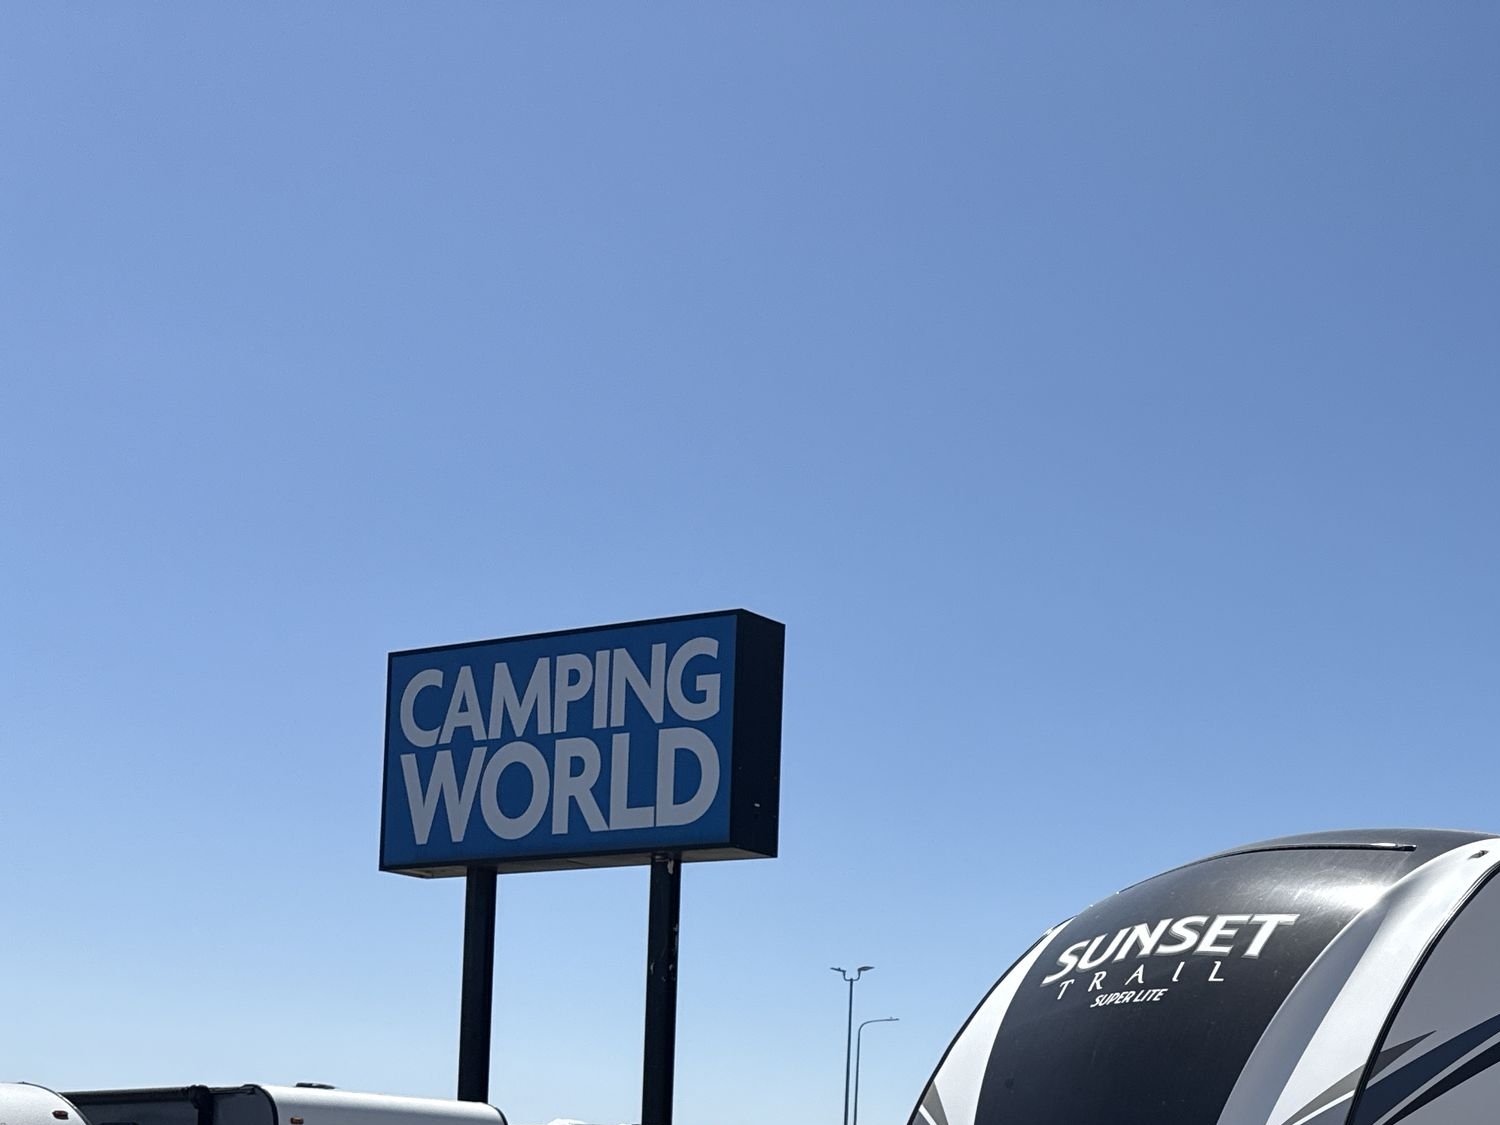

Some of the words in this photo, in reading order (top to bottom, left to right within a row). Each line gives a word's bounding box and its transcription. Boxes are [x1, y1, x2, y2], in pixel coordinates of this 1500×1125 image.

[400, 636, 720, 747] CAMPING
[400, 727, 720, 844] WORLD
[1040, 914, 1300, 987] SUNSET
[1057, 961, 1225, 1001] TRAIL
[1090, 990, 1132, 1008] SUPER
[1133, 988, 1169, 1003] LITE
